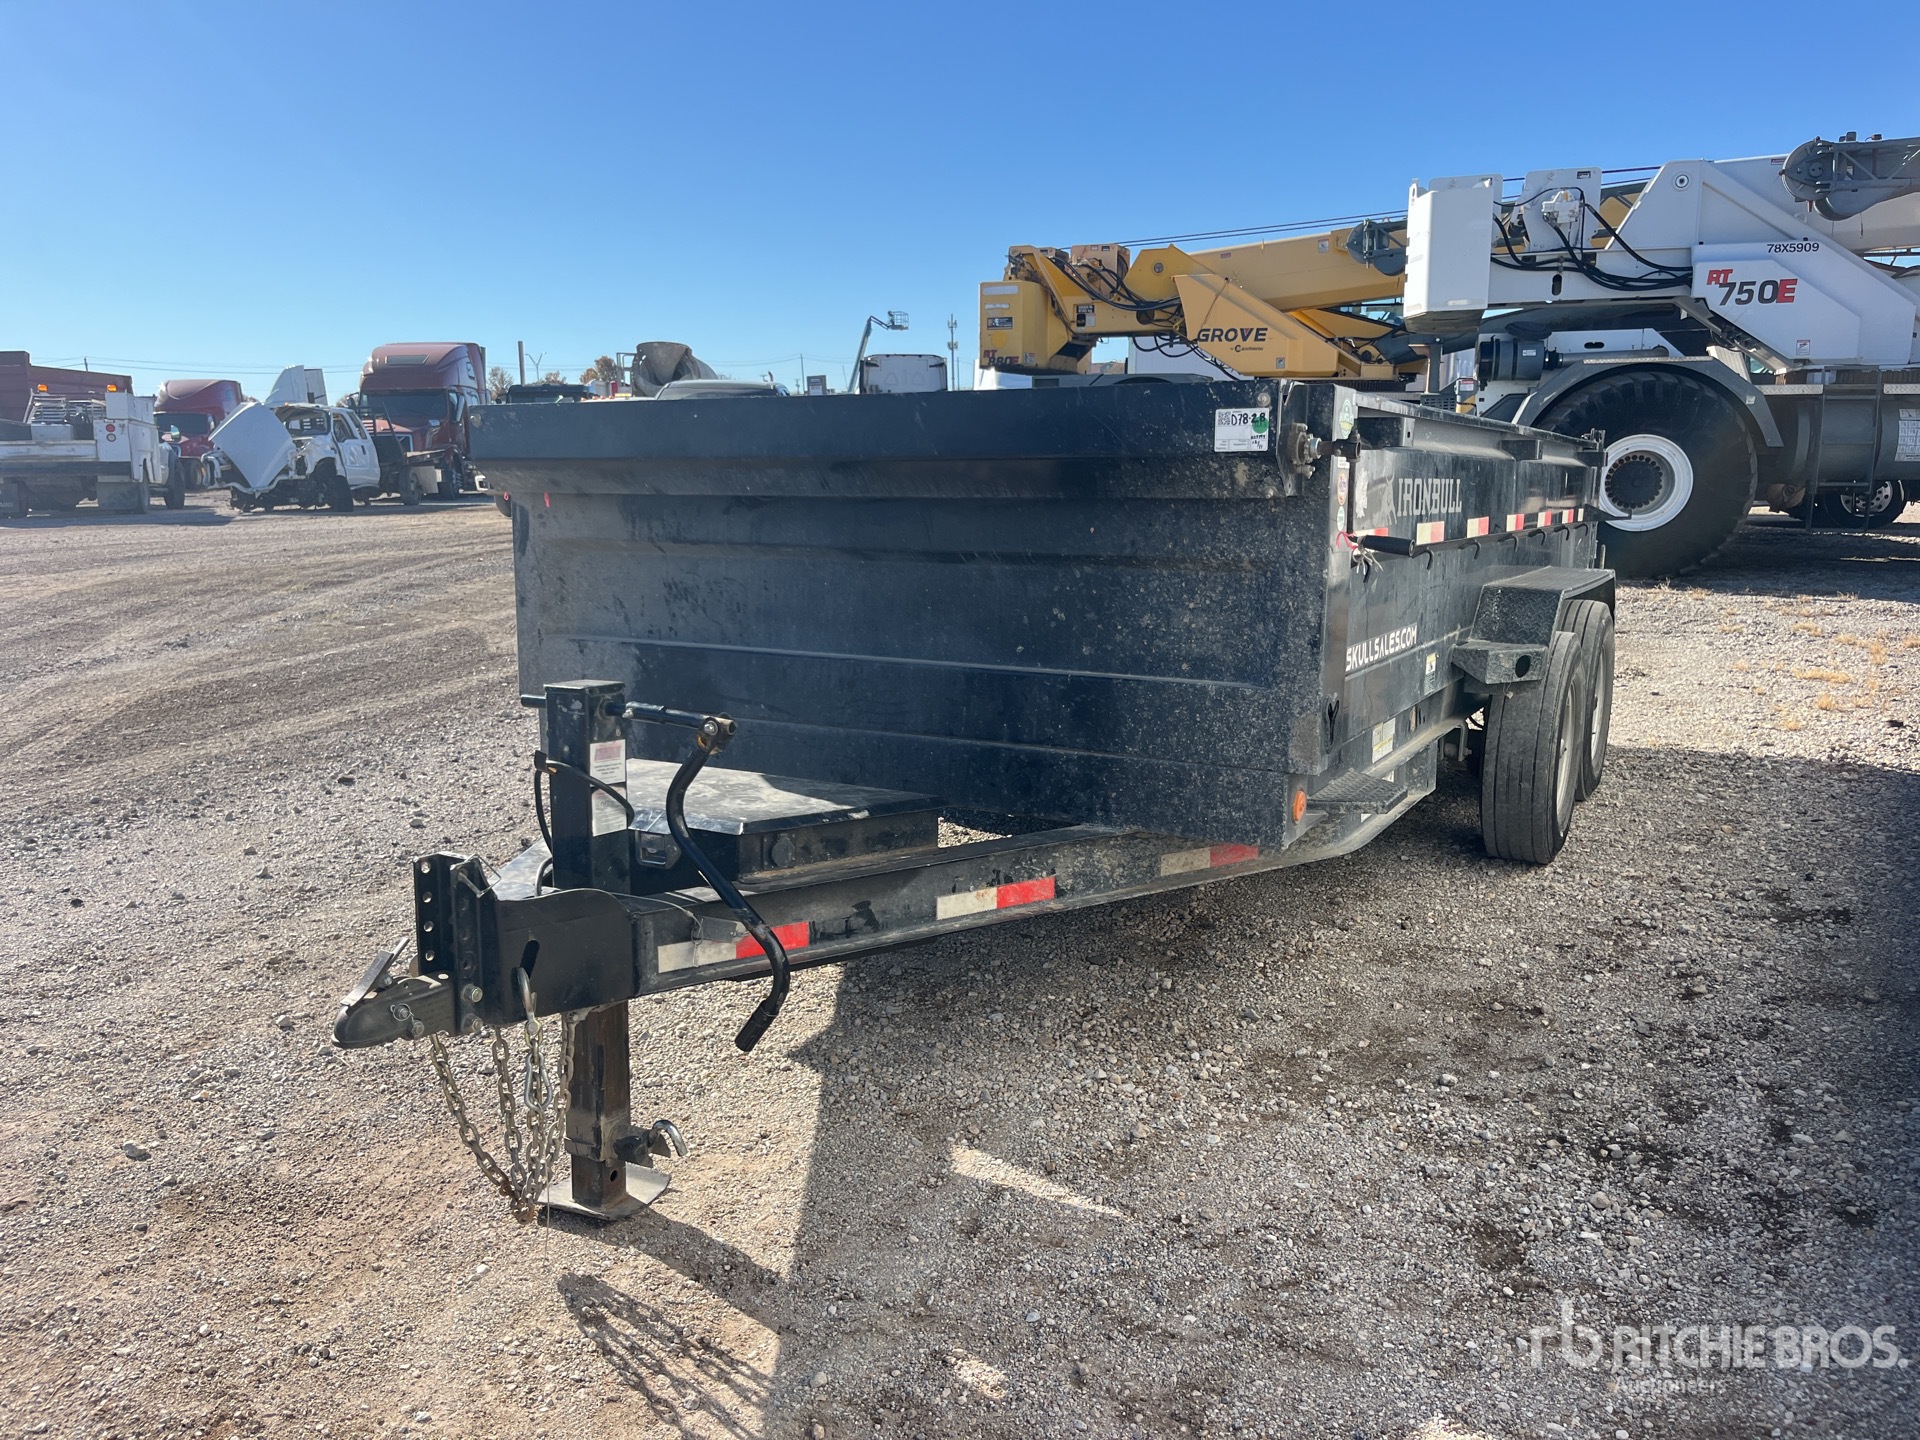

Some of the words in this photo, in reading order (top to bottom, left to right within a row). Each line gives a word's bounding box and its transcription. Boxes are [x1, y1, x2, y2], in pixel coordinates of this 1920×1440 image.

[1767, 242, 1820, 253] 78X5909
[1706, 268, 1734, 286] RT
[1719, 278, 1799, 306] 750E
[1197, 327, 1269, 343] GROVE
[983, 349, 998, 359] RT
[1397, 478, 1463, 517] IRONBULL
